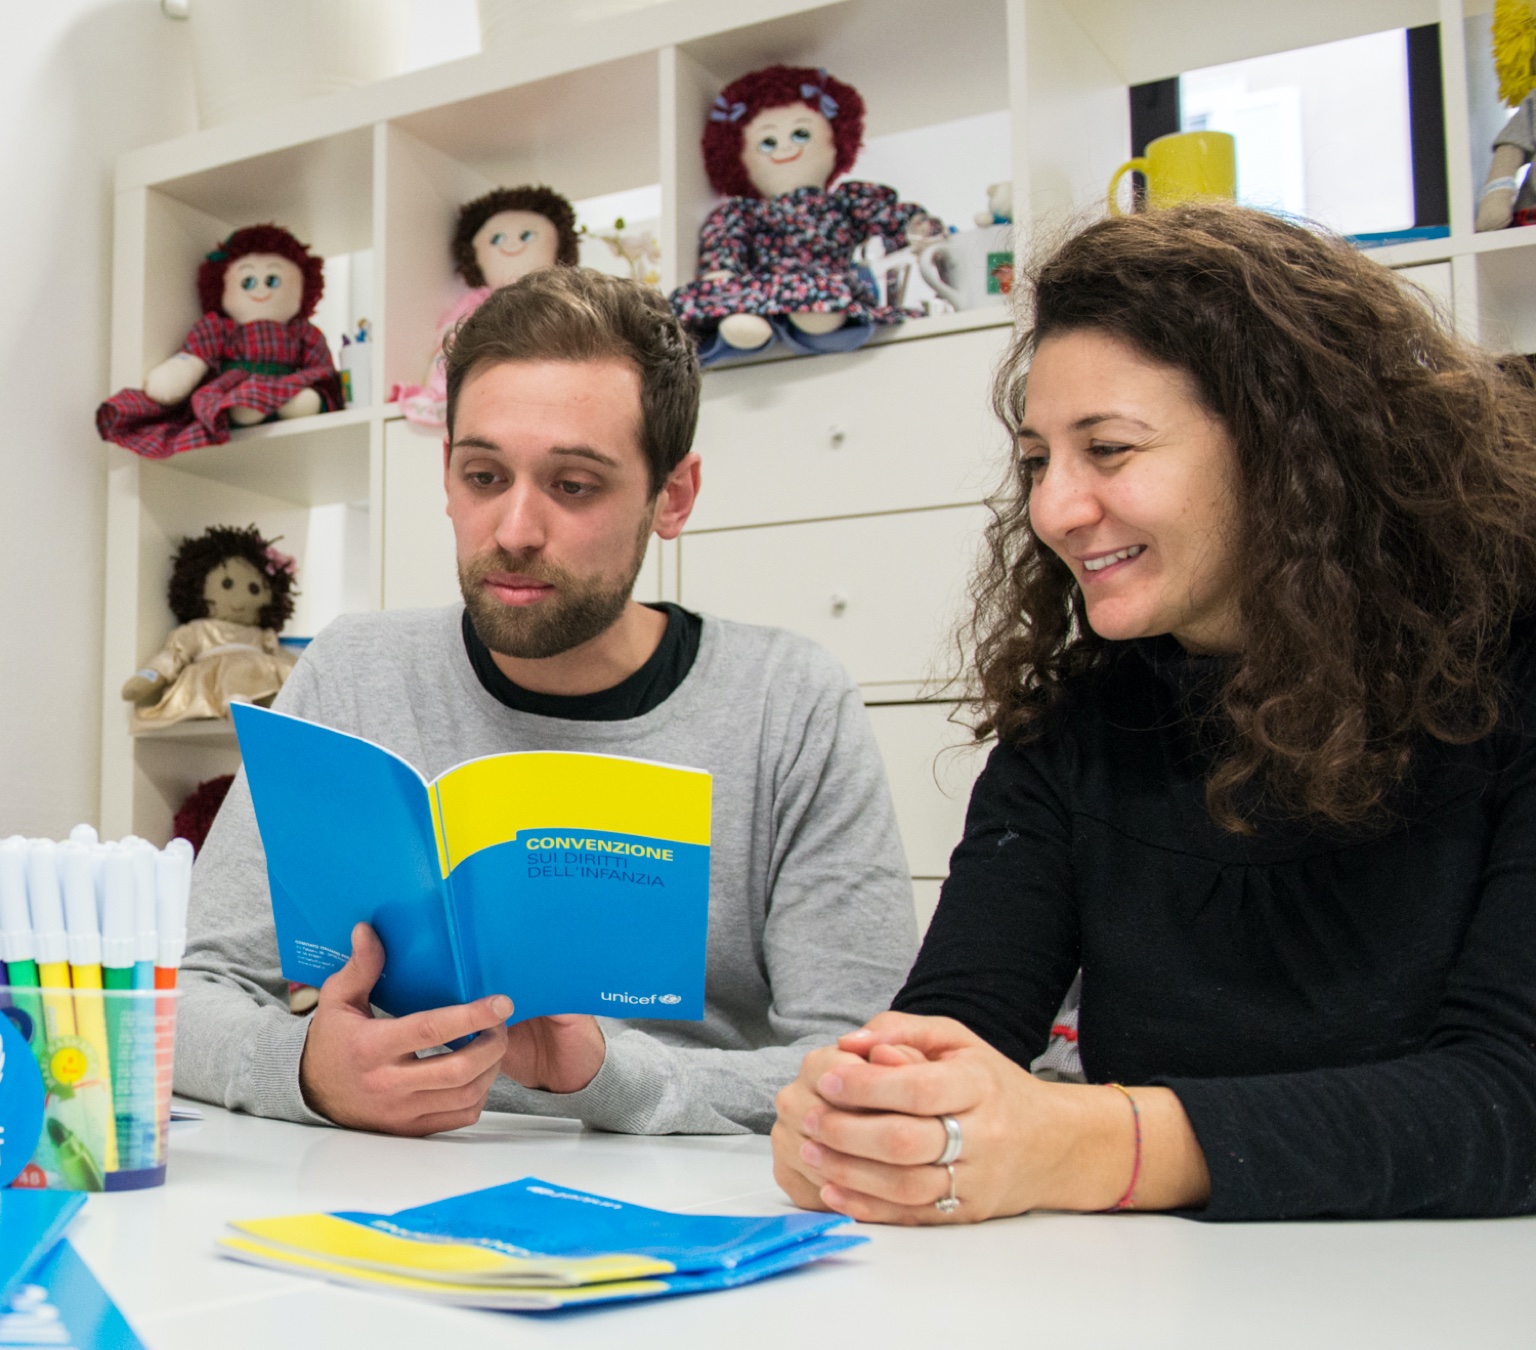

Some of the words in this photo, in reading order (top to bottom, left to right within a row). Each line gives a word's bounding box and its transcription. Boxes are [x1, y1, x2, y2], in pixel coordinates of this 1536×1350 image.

[526, 837, 674, 862] CONVENZIONE
[527, 852, 557, 865] SUI
[564, 852, 628, 869] DIRITTI
[527, 865, 665, 887] DELL'INFANZIA
[600, 991, 658, 1005] unicef
